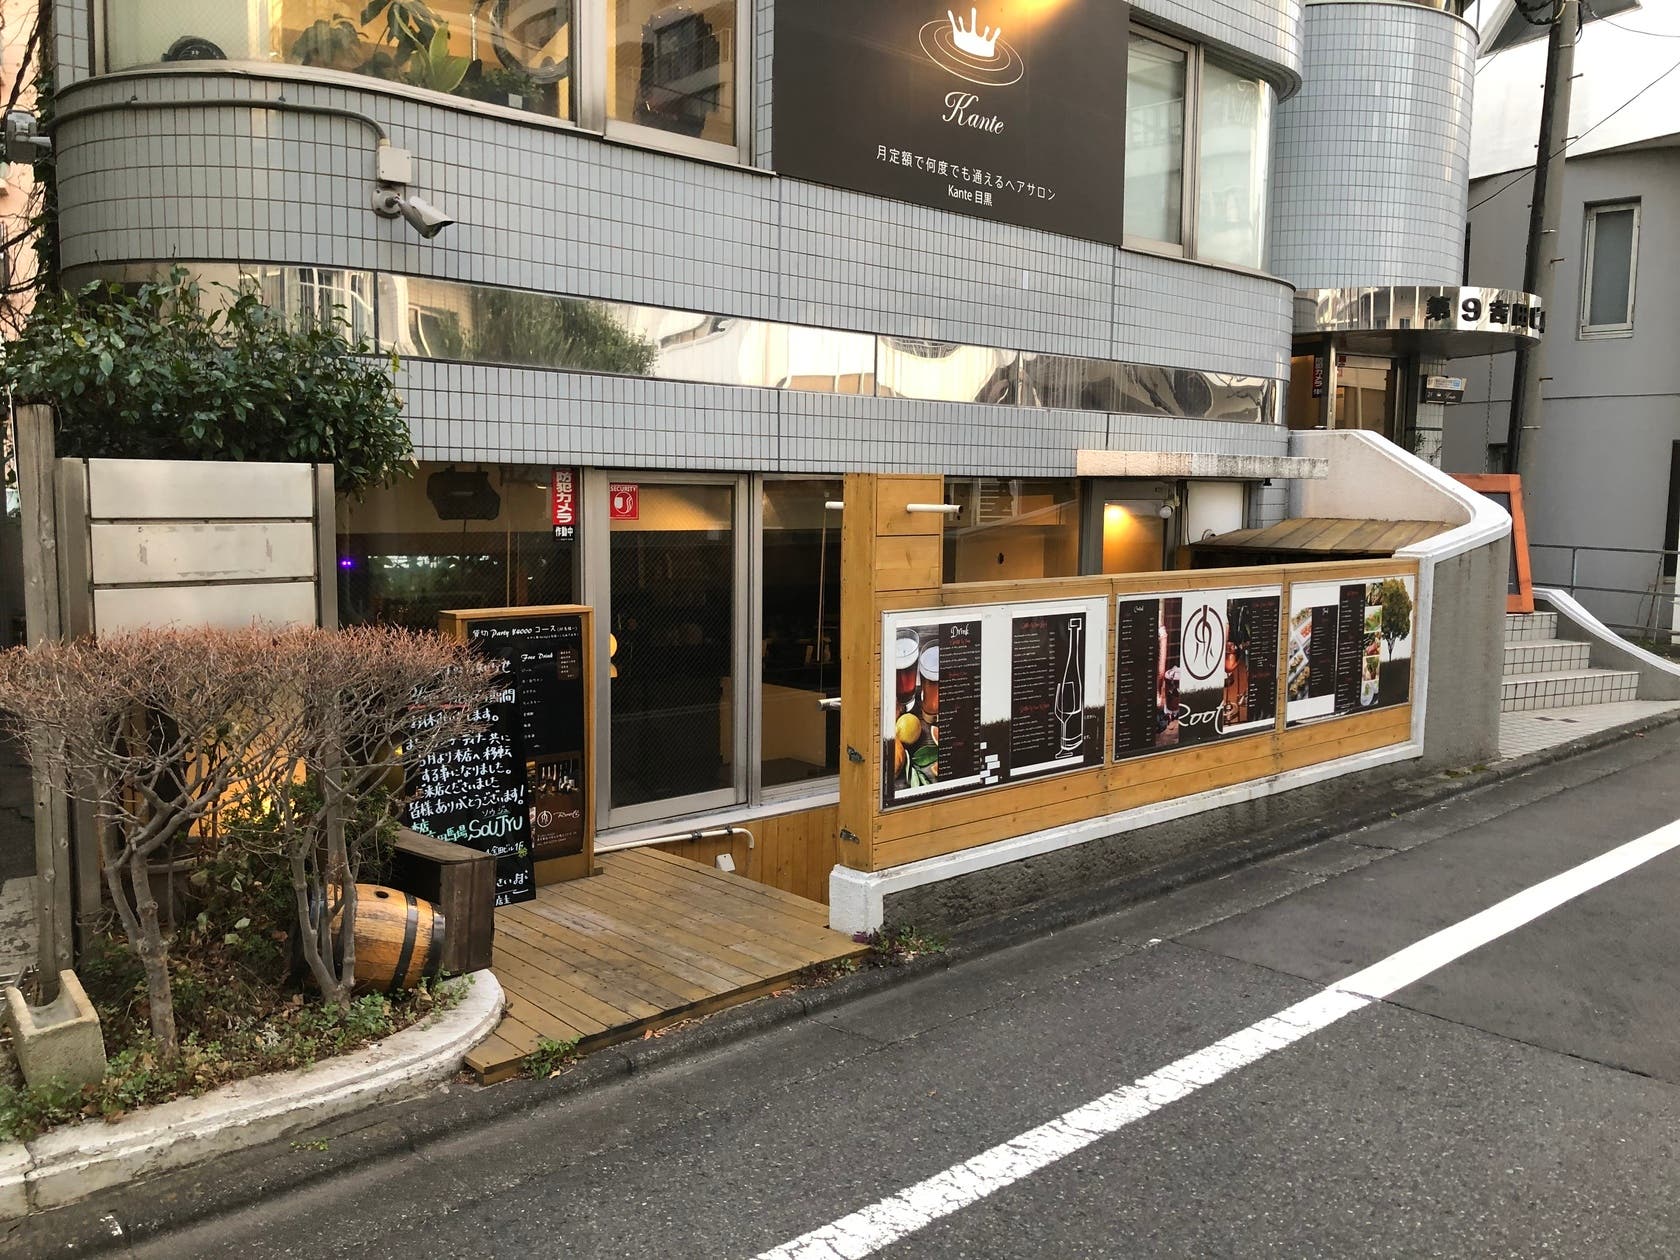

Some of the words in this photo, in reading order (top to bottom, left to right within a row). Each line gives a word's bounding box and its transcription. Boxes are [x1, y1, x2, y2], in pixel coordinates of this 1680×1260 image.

[942, 91, 1005, 135] Kante
[876, 144, 1057, 201] 月定額で何度でも通えるヘアサロン
[948, 184, 972, 202] Kante
[974, 190, 993, 207] 目黒
[556, 471, 573, 523] 防犯カメラ
[535, 625, 556, 633] コース
[950, 624, 969, 638] Drink
